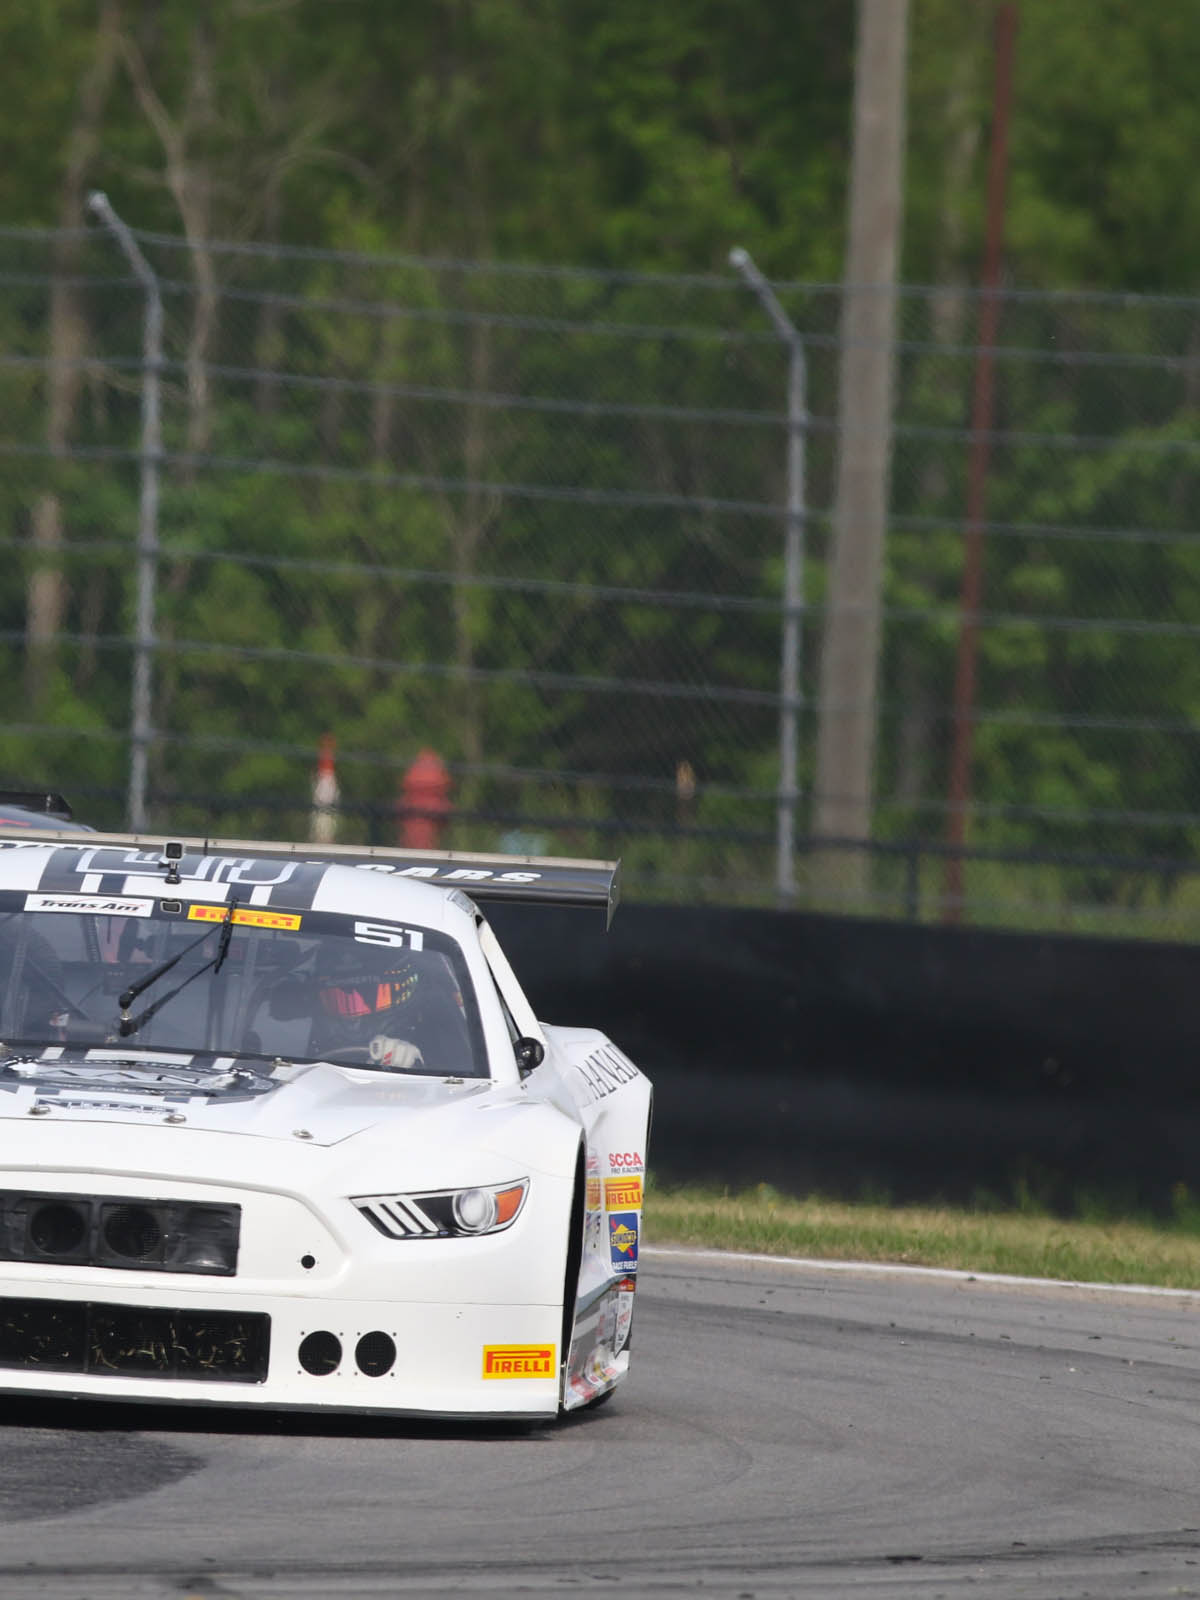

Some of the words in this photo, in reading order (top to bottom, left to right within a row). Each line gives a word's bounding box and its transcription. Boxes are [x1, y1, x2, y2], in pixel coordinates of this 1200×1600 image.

[38, 899, 97, 910] Trans
[101, 902, 141, 913] Am
[354, 921, 424, 952] 51
[608, 1151, 643, 1168] SCCA
[486, 1350, 552, 1374] PIRELLI
